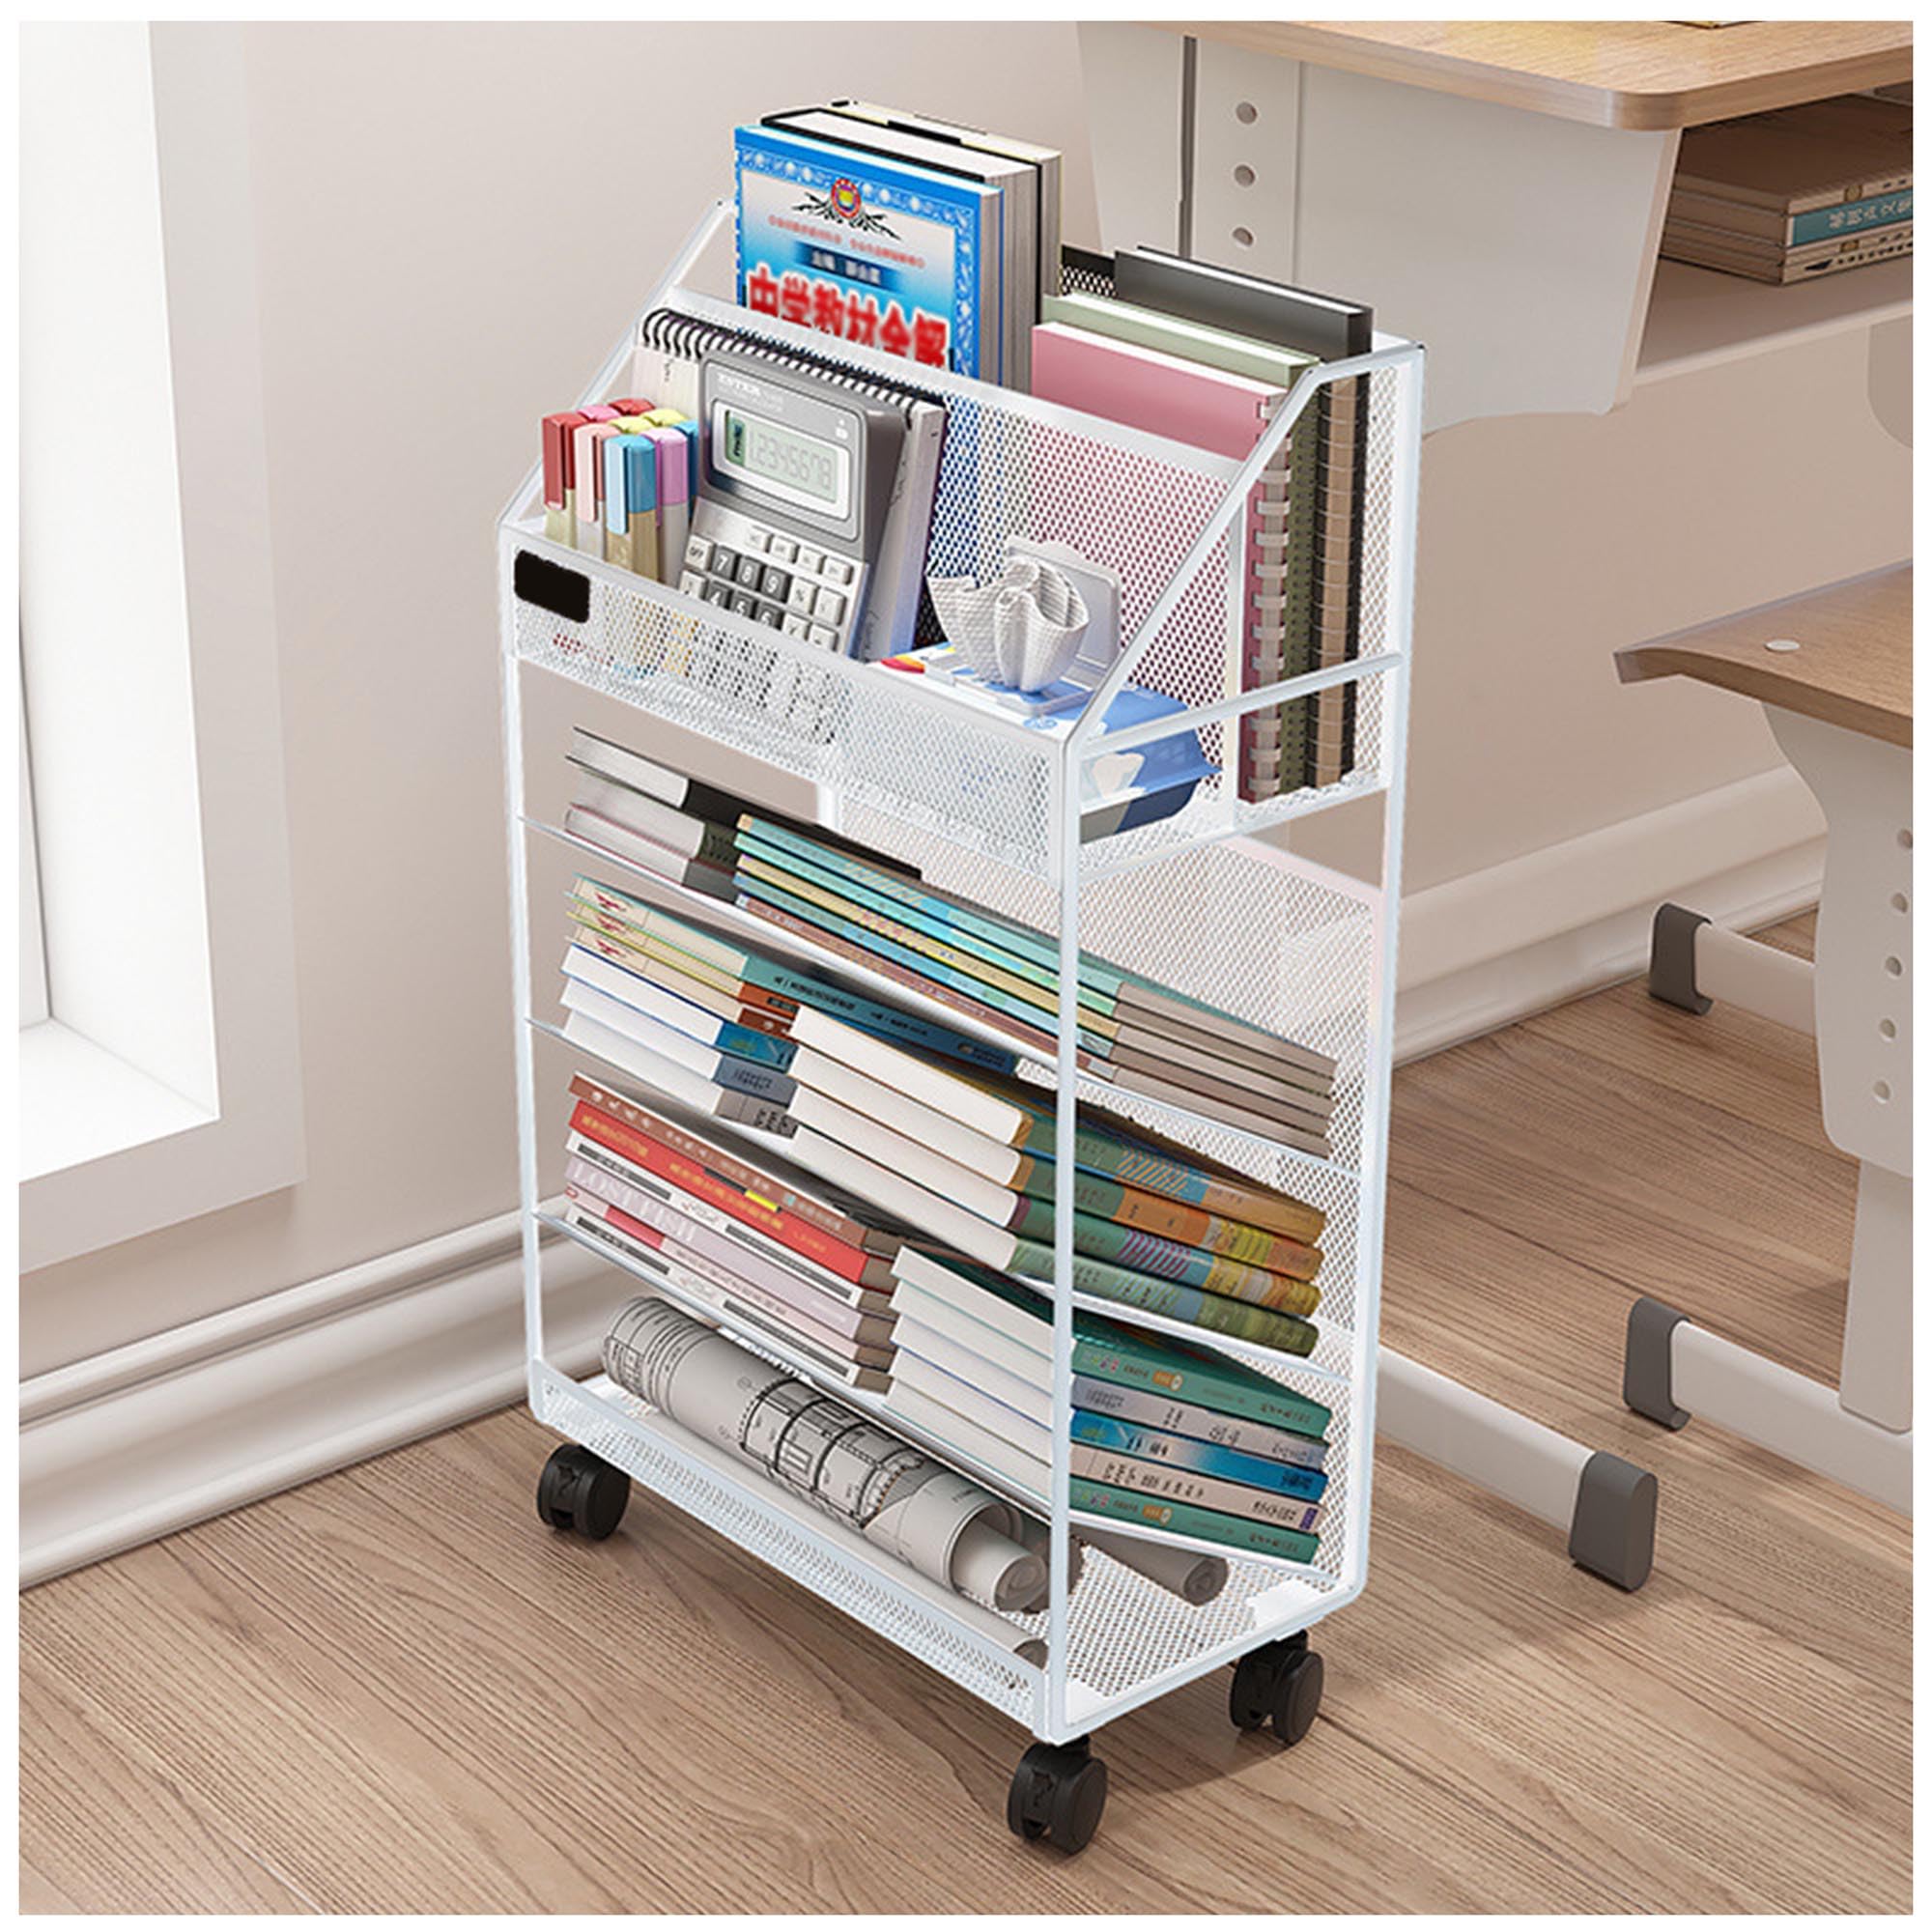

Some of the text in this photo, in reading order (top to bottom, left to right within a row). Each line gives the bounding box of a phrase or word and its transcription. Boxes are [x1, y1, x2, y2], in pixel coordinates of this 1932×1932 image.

[741, 565, 753, 582] 8
[767, 576, 779, 593] 9
[572, 1161, 633, 1208] LOST
[638, 1201, 697, 1242] FISH
